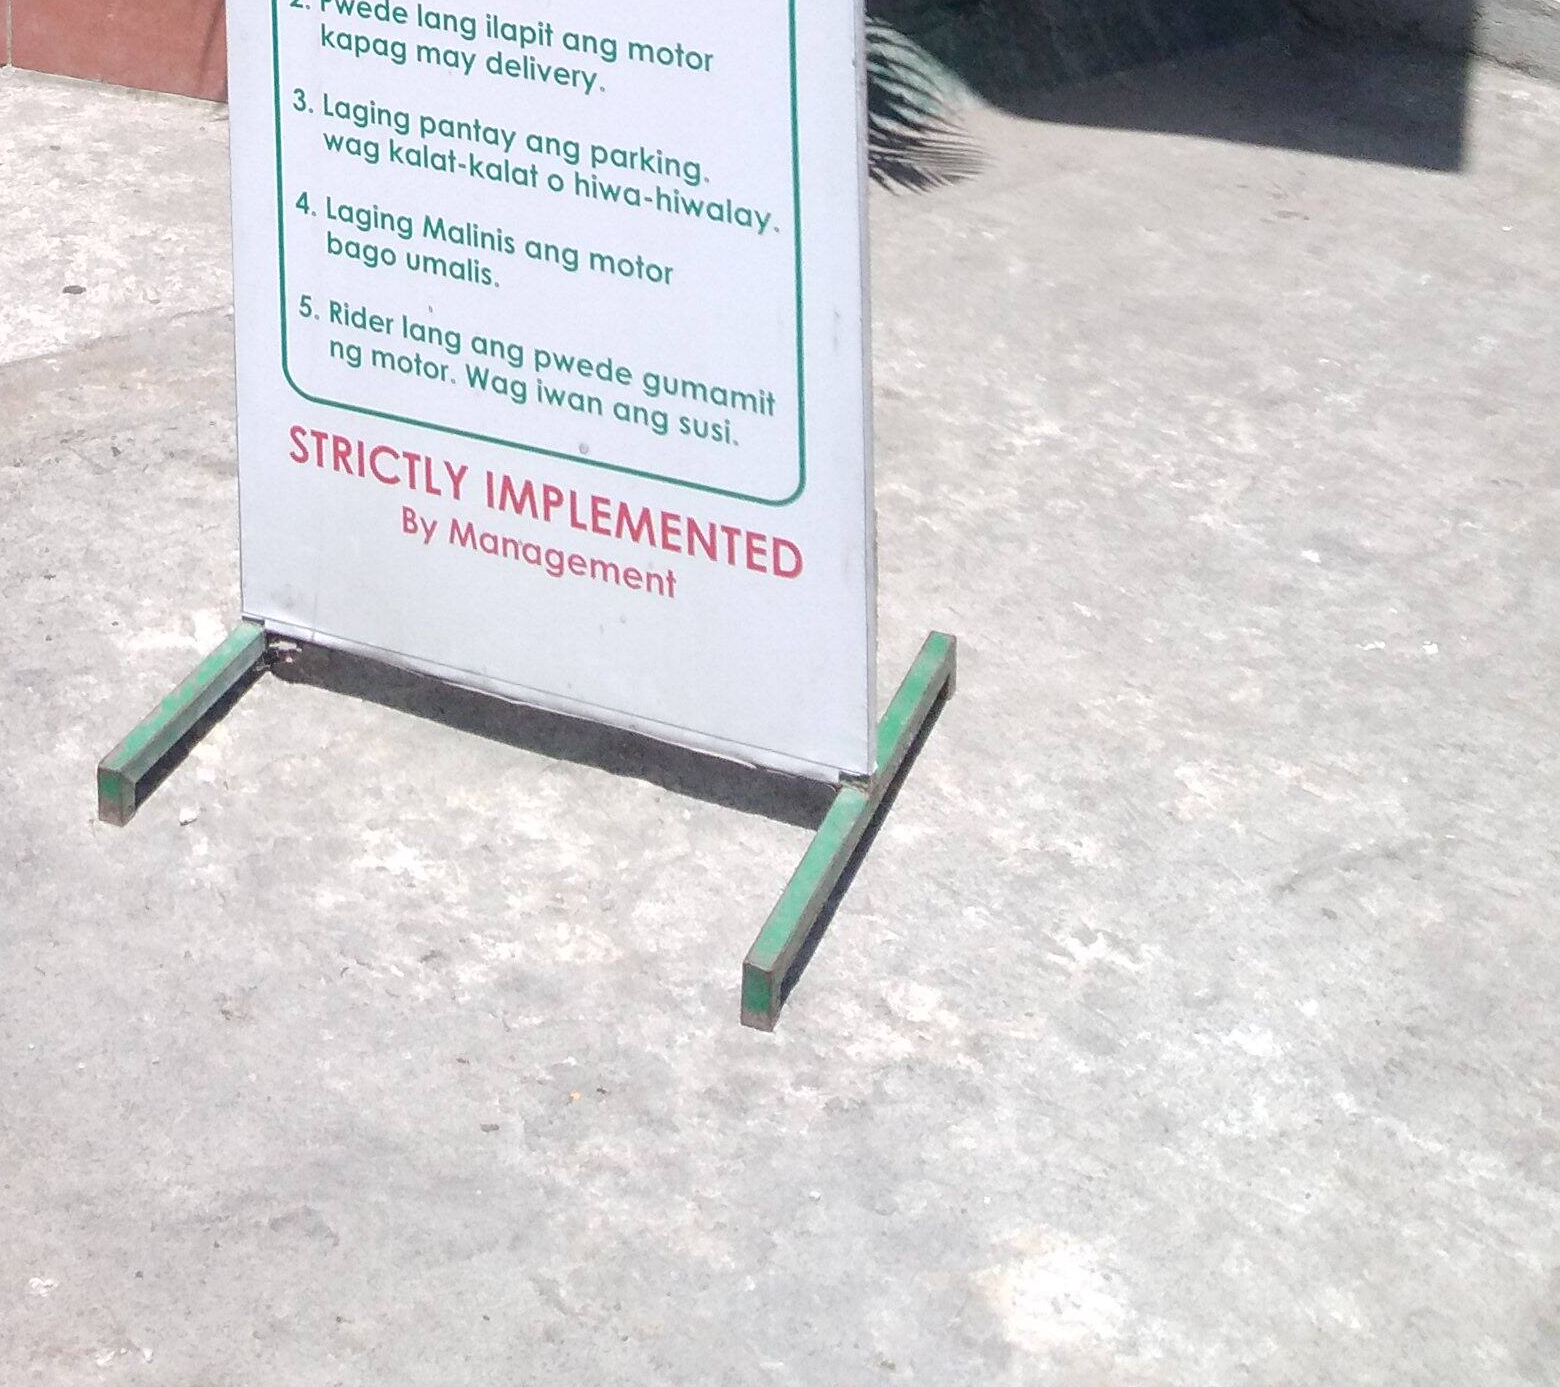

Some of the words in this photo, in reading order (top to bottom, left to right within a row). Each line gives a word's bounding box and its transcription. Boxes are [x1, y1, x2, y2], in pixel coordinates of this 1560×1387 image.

[321, 23, 407, 65] kapag
[416, 43, 476, 75] may
[486, 53, 605, 95] delivery.
[417, 4, 476, 40] lang
[486, 13, 553, 51] ilapit
[562, 32, 617, 62] ang
[628, 40, 713, 72] motor
[293, 88, 314, 113] 3.
[323, 93, 409, 135] Laging
[420, 109, 516, 153] pantay
[526, 135, 580, 165] ang
[591, 144, 710, 186] parking.
[323, 133, 380, 164] wag
[389, 140, 538, 189] kalat-kalat
[547, 174, 564, 194] o
[575, 172, 780, 235] hiwa-hiwalay.
[296, 192, 316, 217] 4.
[327, 196, 413, 240] Laging
[423, 217, 515, 254] Malinis
[525, 242, 579, 271] ang
[590, 253, 673, 285] motor
[327, 232, 396, 268] bago
[407, 249, 500, 288] umalis.
[299, 296, 320, 321] 5.
[329, 300, 394, 335] Rider
[403, 316, 461, 355] lang
[471, 338, 524, 367] ang
[535, 345, 632, 385] pwede
[643, 371, 775, 416] gumamit
[329, 338, 362, 368] ng
[371, 349, 456, 384] motor.
[466, 364, 527, 403] Wag
[537, 379, 602, 415] iwan
[613, 405, 668, 436] ang
[679, 413, 739, 446] susi.
[289, 425, 469, 501] STRICTLY
[487, 471, 802, 580] IMPLEMENTED
[402, 506, 437, 545] By
[449, 519, 677, 599] Management
